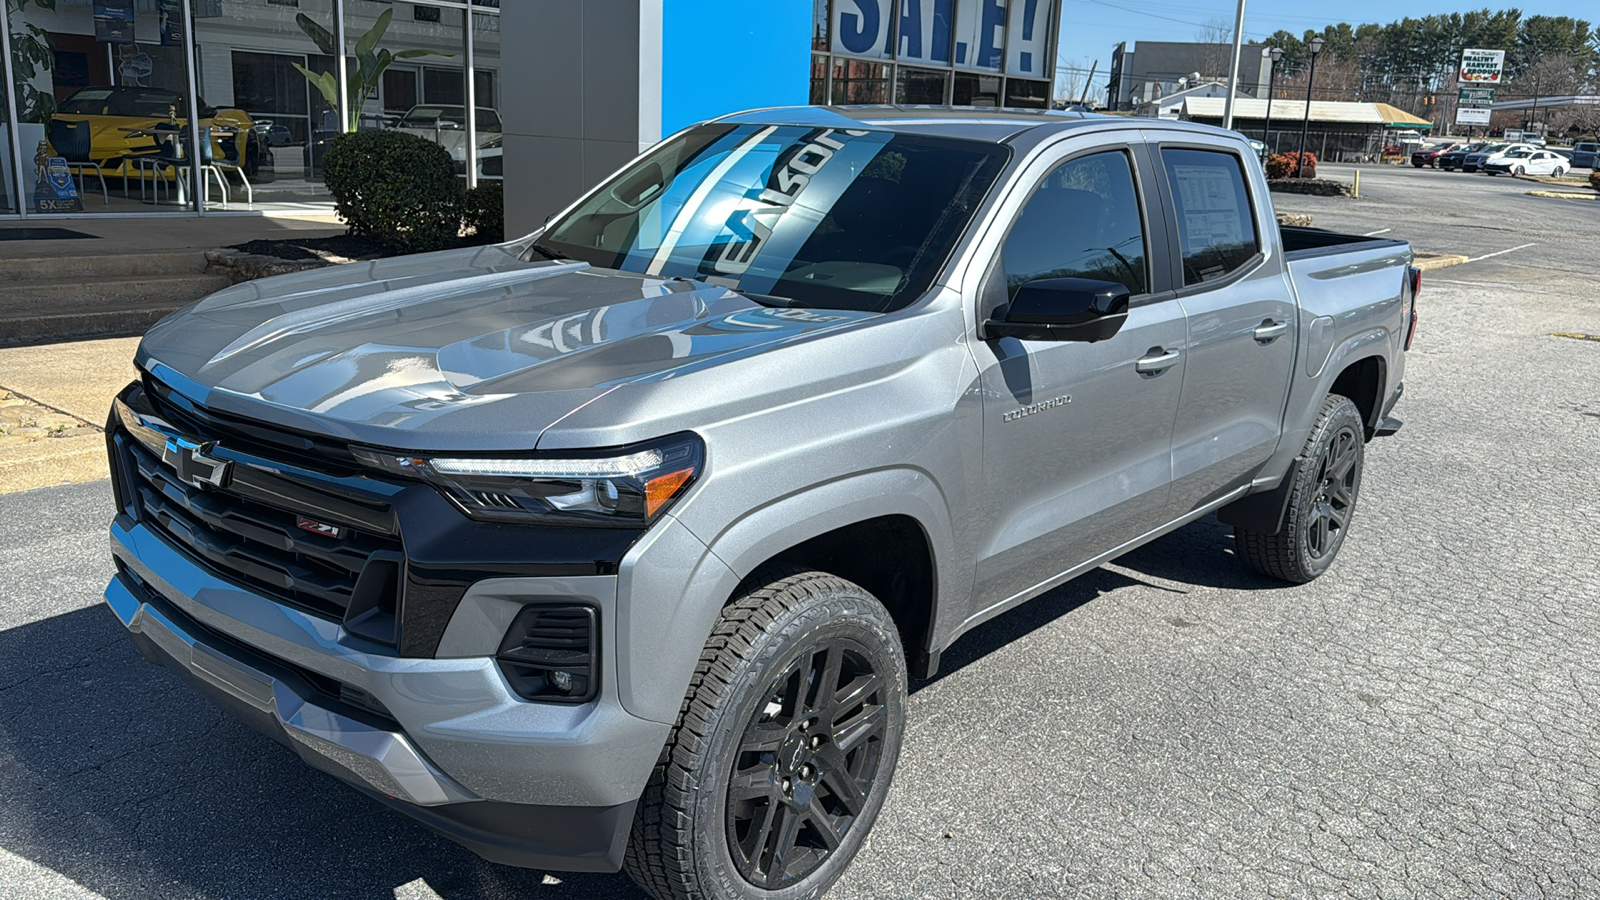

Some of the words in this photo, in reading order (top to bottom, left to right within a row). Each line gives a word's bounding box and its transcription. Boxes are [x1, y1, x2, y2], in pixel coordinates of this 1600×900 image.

[840, 0, 1037, 72] SALE!
[1463, 55, 1495, 63] HEALTHY
[40, 199, 57, 210] 5X
[1003, 395, 1071, 422] COLORADO
[297, 517, 339, 538] Z71
